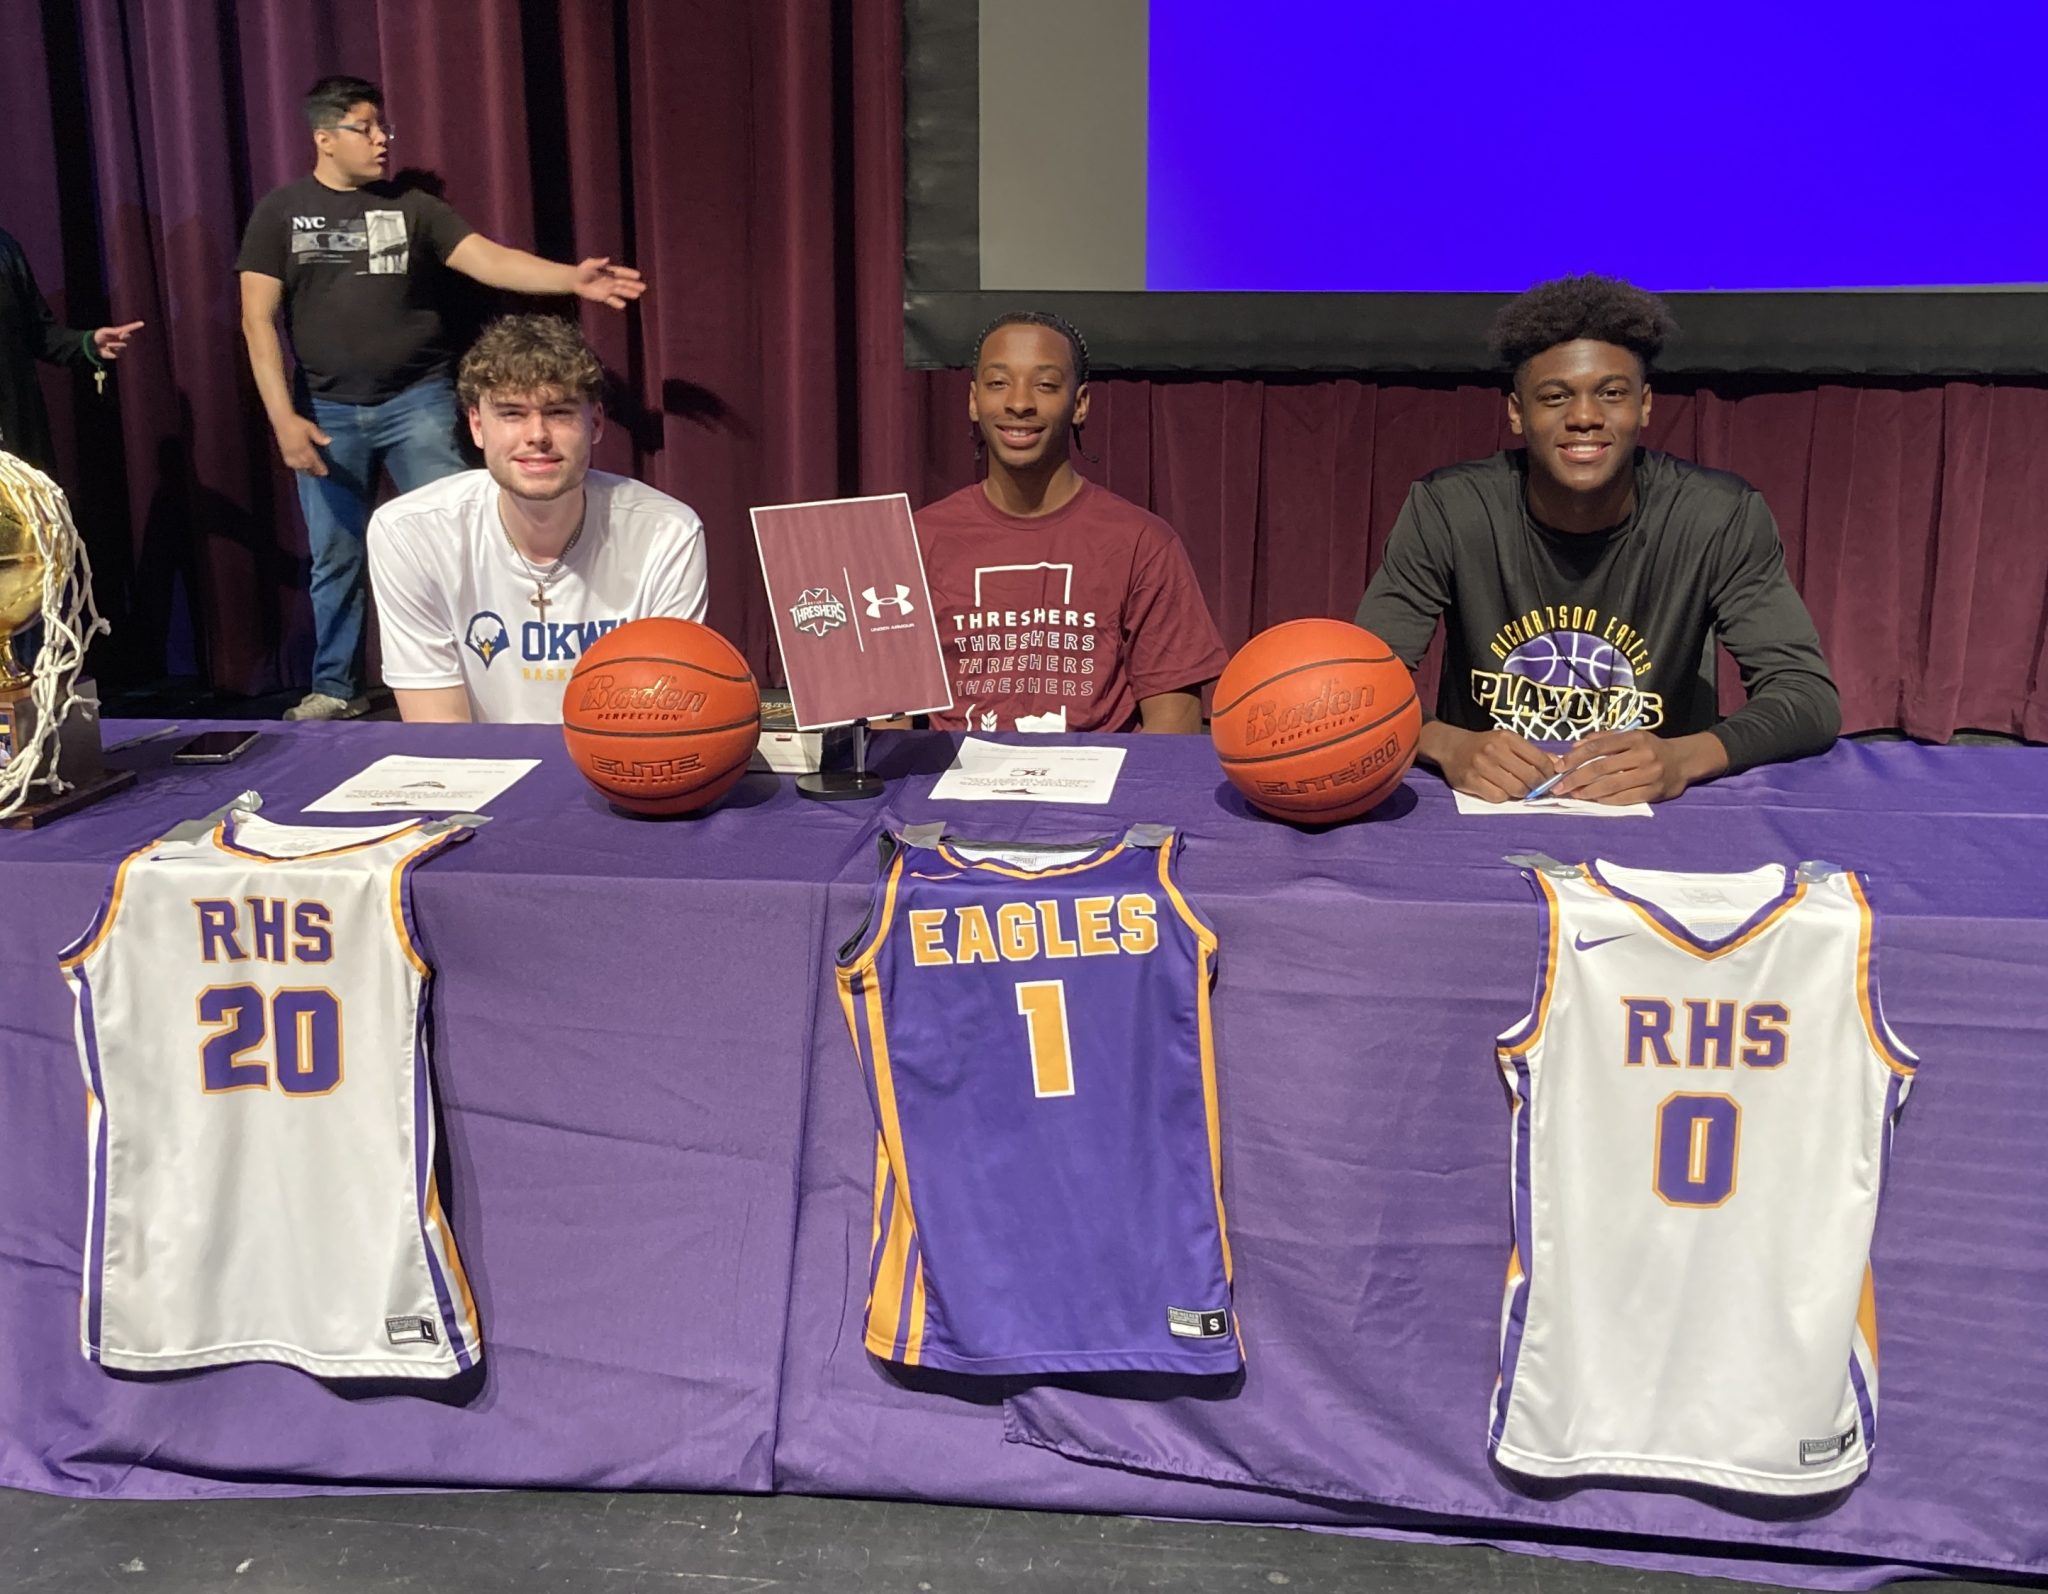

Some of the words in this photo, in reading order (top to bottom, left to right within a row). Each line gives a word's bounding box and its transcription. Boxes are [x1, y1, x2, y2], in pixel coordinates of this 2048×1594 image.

[292, 216, 326, 230] NYC
[789, 602, 847, 628] THRESHERS
[953, 608, 1096, 631] THRESHERS
[522, 617, 628, 662] OKW
[954, 630, 1095, 652] THRESHERS
[1603, 616, 1652, 676] EAGLES
[959, 654, 1094, 674] THRESHERS
[579, 675, 708, 712] Baden
[956, 677, 1094, 697] THRESHERS
[597, 713, 679, 721] PERFECTION
[1246, 680, 1375, 746] Baden
[1271, 716, 1355, 748] PERFECTION
[591, 753, 699, 777] ELITE
[1361, 738, 1397, 775] PRO
[191, 896, 335, 965] RHS
[908, 893, 1159, 966] EAGLES
[195, 981, 344, 1097] 20
[1015, 979, 1075, 1098] 1
[1620, 995, 1791, 1070] RHS
[1652, 1090, 1743, 1209] 0
[423, 1325, 432, 1337] L
[1208, 1317, 1220, 1332] S
